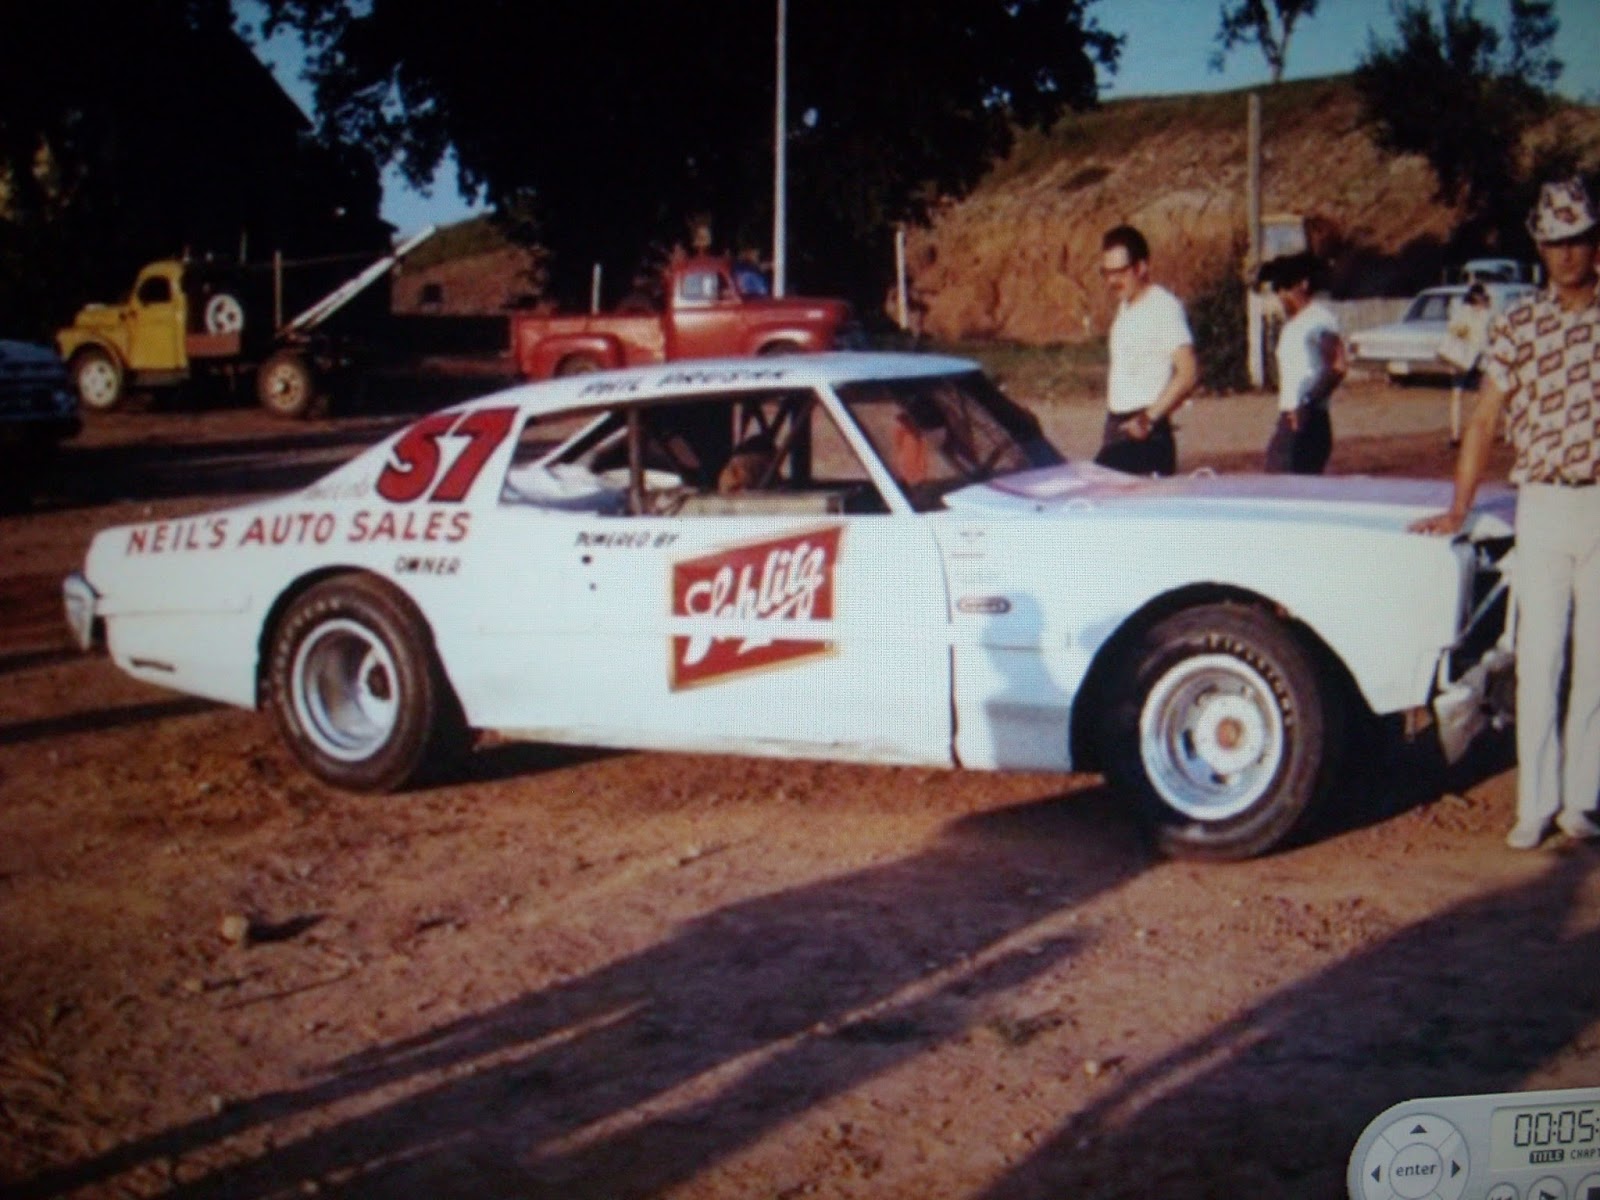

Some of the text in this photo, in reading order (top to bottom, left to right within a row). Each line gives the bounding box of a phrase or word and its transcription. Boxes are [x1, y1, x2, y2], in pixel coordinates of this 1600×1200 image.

[376, 406, 518, 503] 57
[127, 512, 472, 554] NEIL'S AUTO SALES
[653, 533, 678, 549] BY
[395, 555, 461, 576] OWNER
[683, 543, 826, 666] Schlitz
[1531, 1150, 1563, 1163] TITLE
[1396, 1163, 1437, 1176] enter
